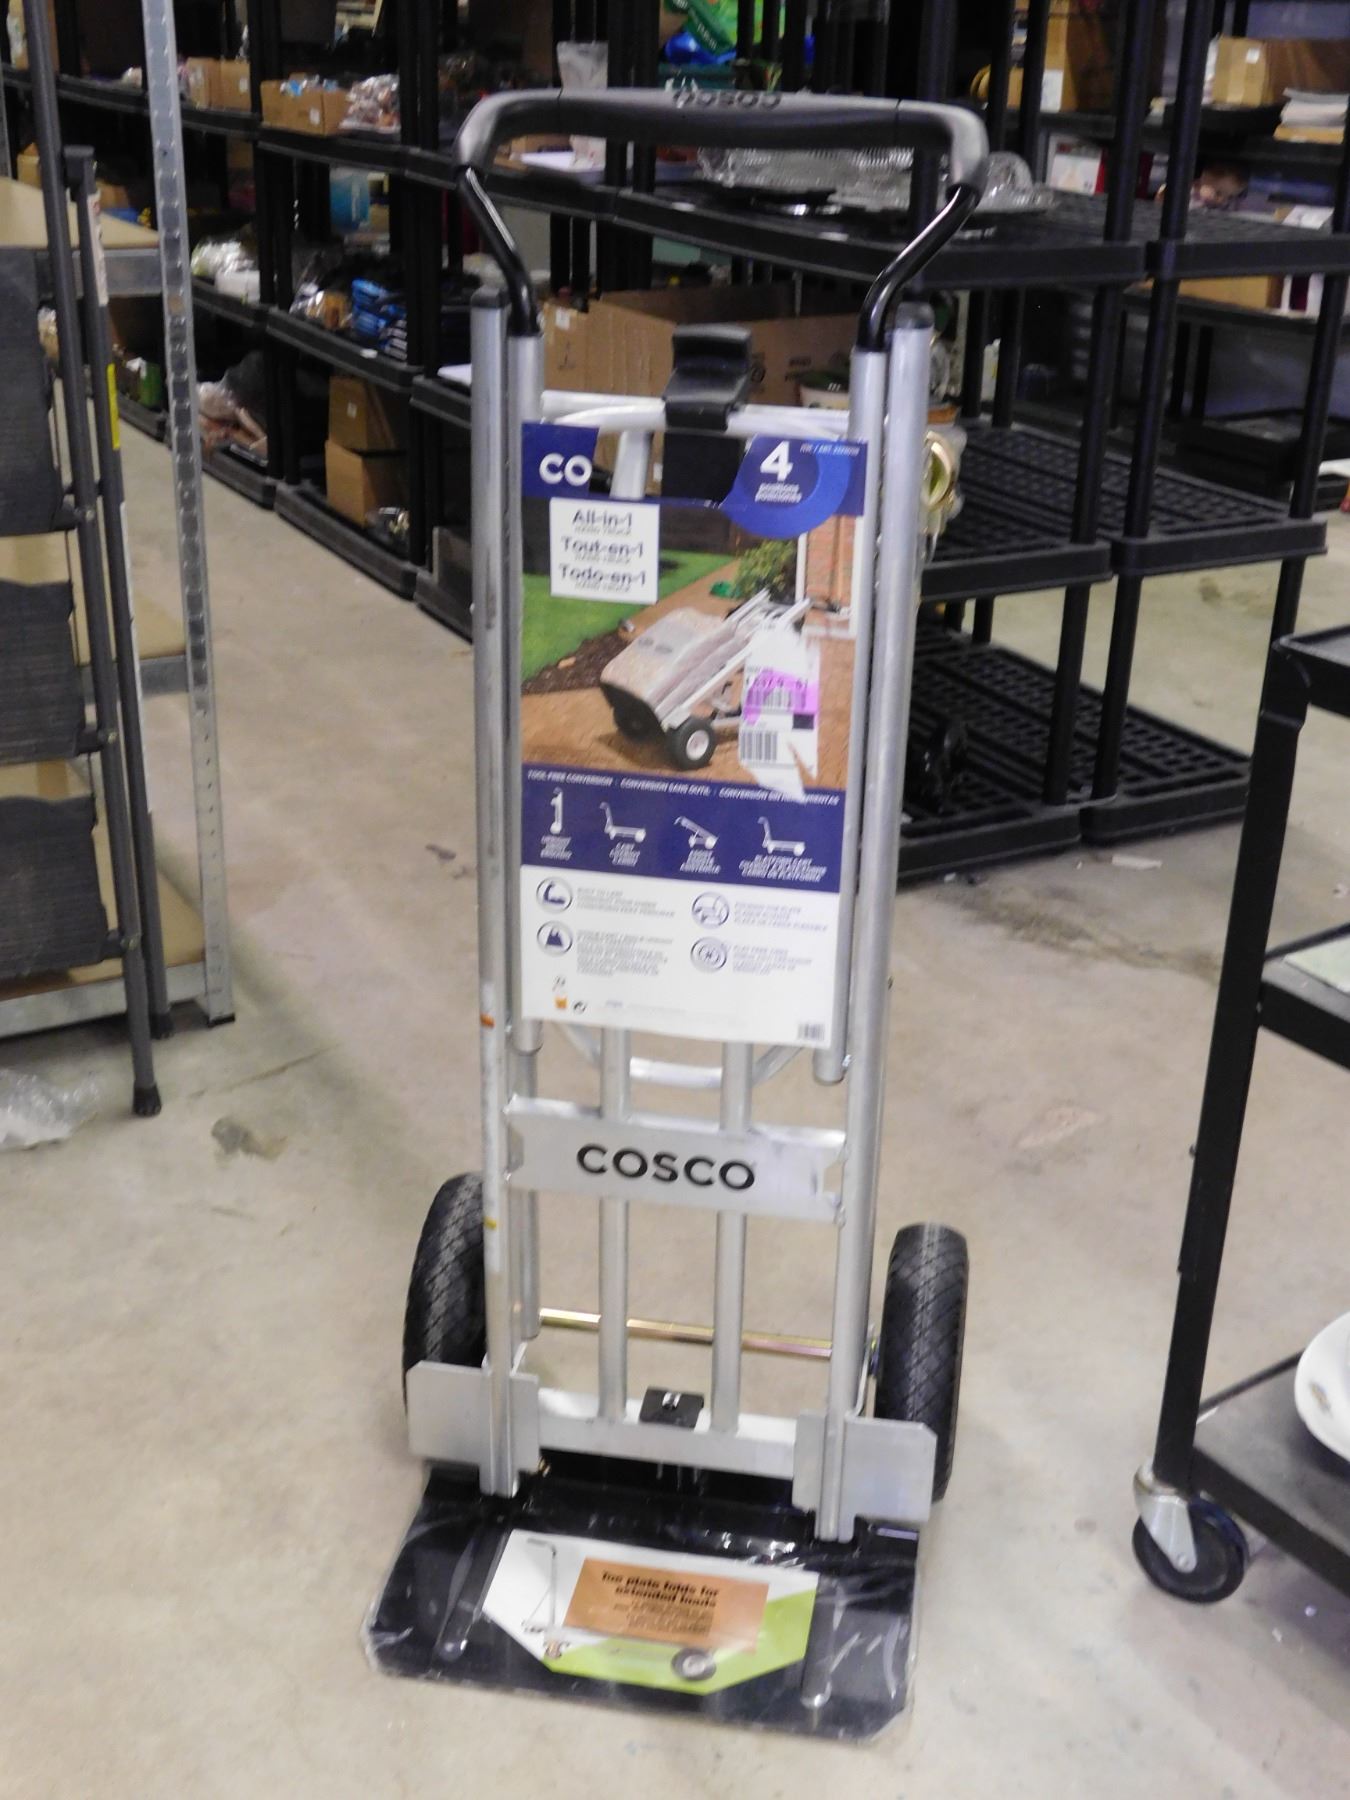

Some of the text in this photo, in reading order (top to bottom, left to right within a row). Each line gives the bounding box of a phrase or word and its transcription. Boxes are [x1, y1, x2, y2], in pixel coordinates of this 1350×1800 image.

[538, 452, 593, 487] CO
[759, 440, 794, 482] 4
[572, 508, 633, 529] All-in-1
[560, 535, 644, 559] Tout-en-1
[558, 563, 646, 588] Todo-en-1
[576, 1143, 756, 1191] COSCO
[615, 1587, 676, 1603] extended
[663, 1581, 697, 1594] folds
[700, 1585, 719, 1598] for
